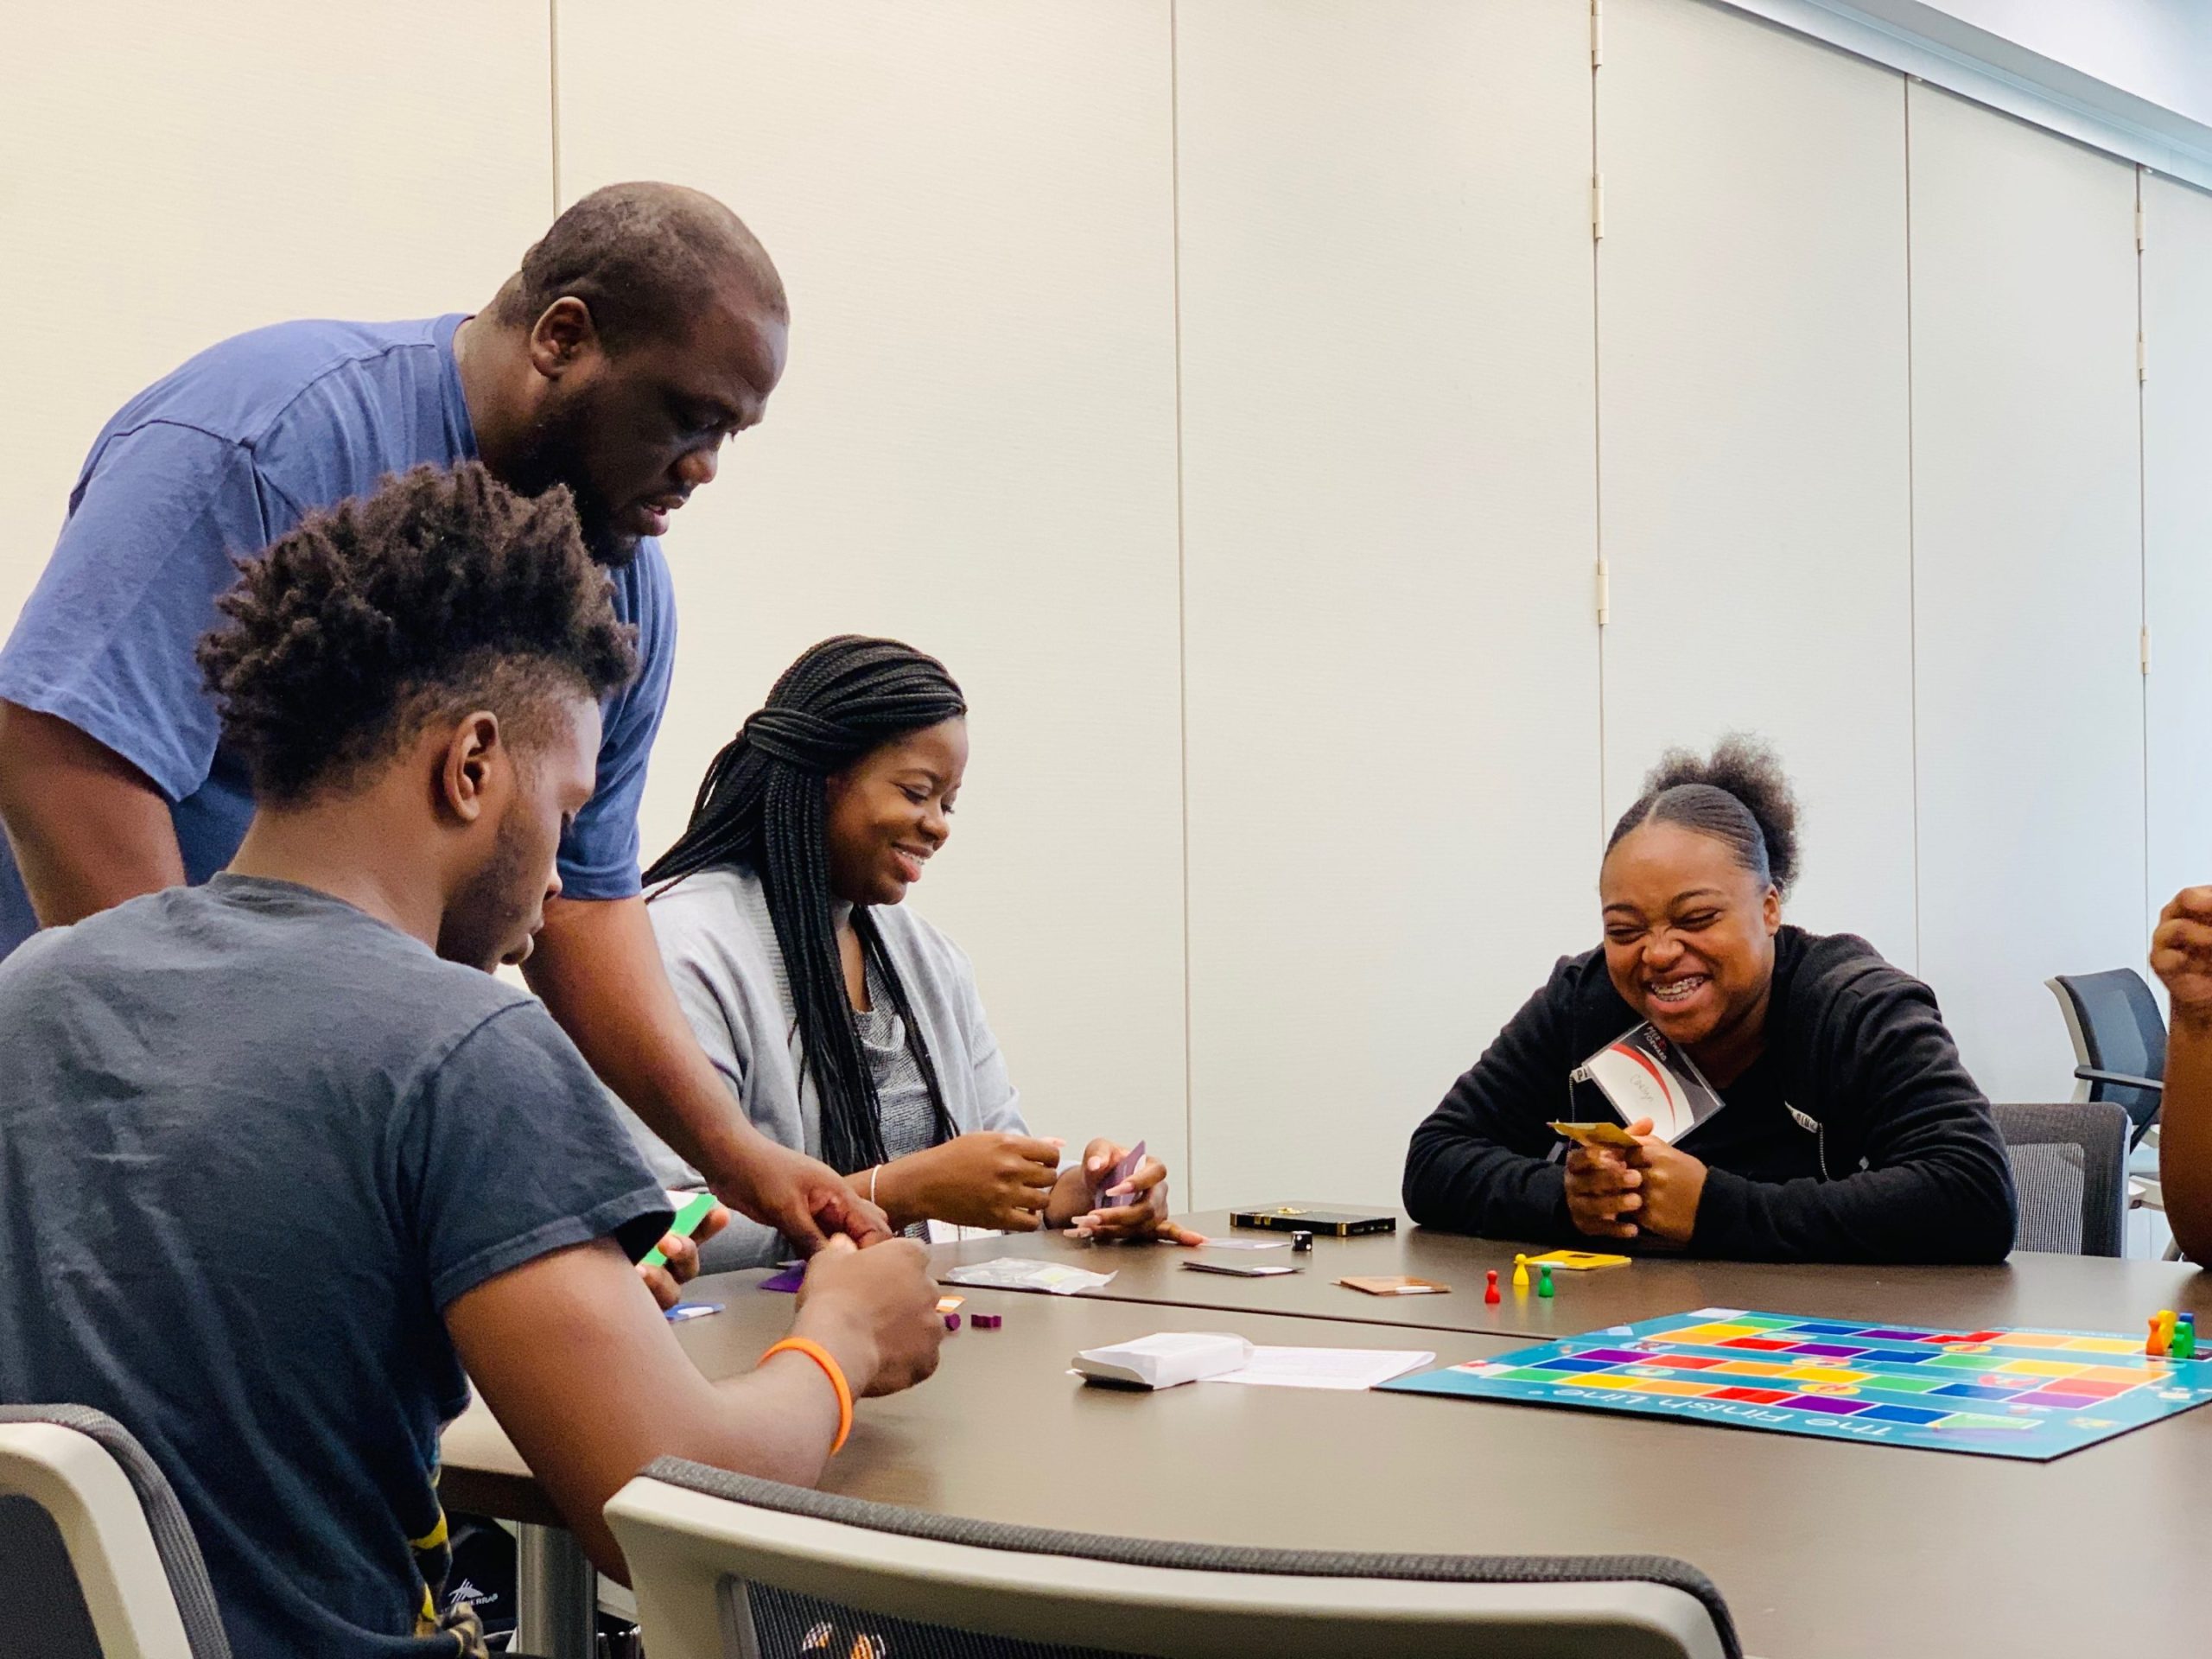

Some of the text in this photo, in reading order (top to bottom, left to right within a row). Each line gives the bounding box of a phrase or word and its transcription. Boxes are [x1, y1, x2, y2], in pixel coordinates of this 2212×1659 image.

[1553, 1389, 1892, 1436] The Finish Line
